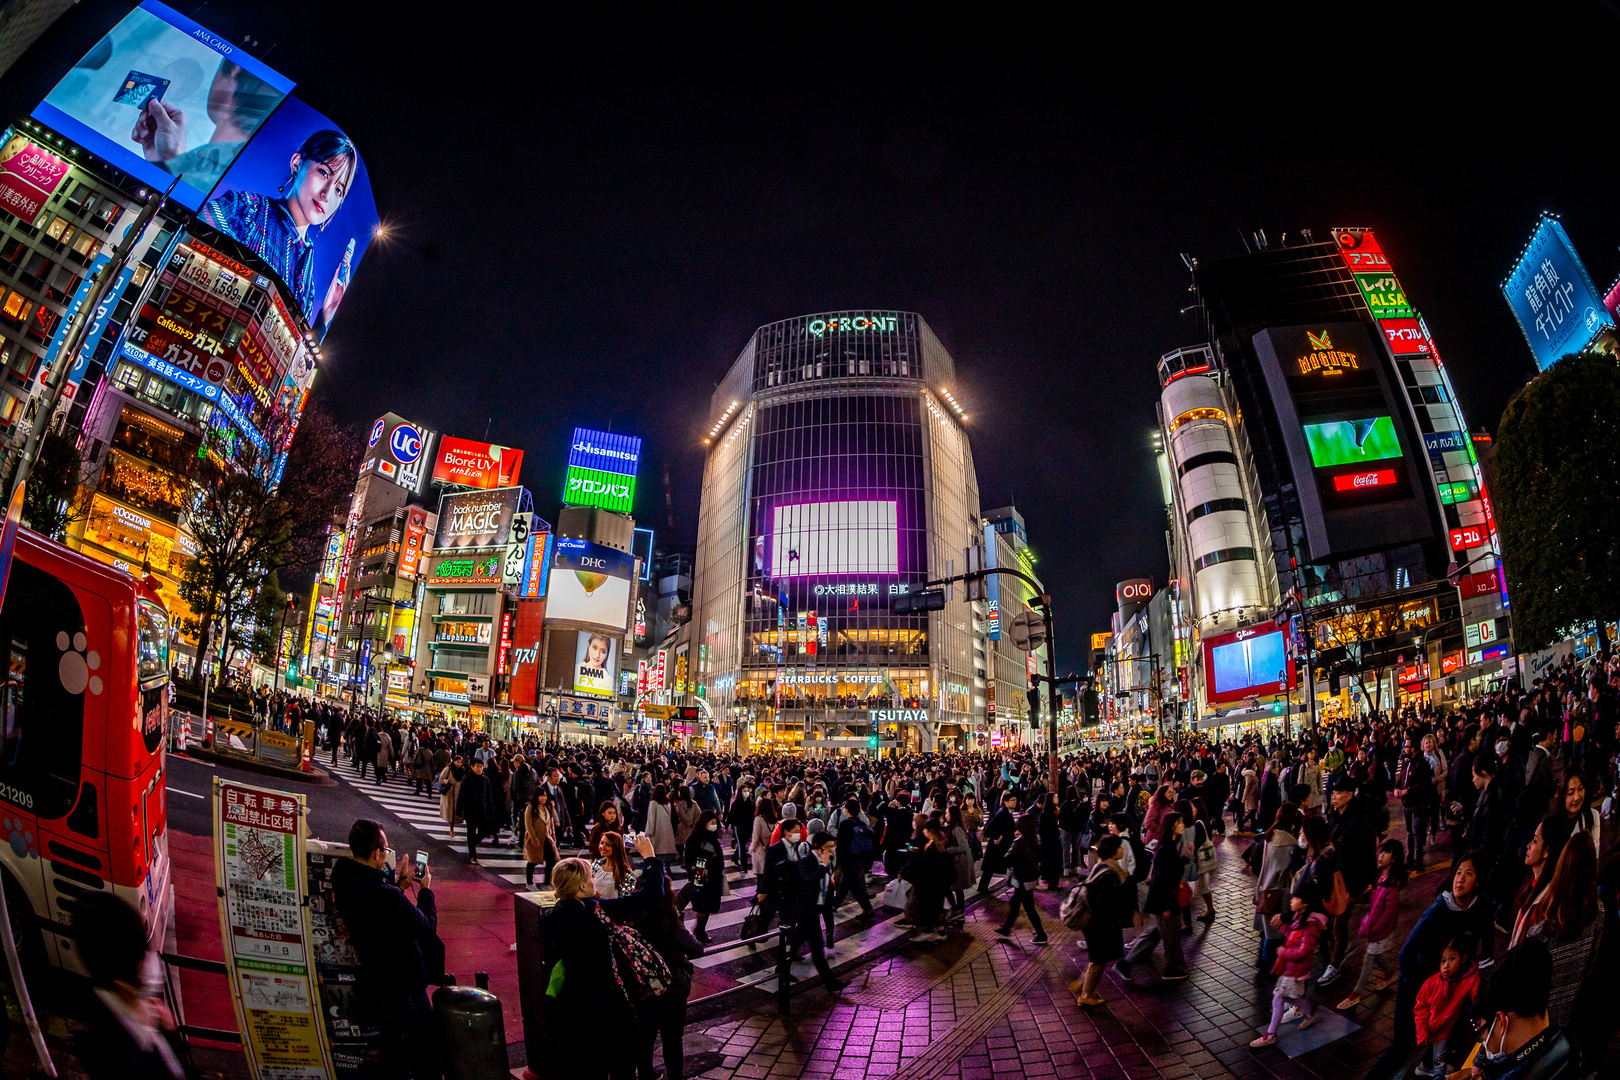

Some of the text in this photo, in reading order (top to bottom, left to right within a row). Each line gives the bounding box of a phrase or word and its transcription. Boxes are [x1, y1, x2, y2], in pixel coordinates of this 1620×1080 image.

[193, 29, 233, 56] ANA CARD
[22, 164, 53, 185] クリニック
[30, 154, 62, 176] 品川スキン
[172, 254, 186, 266] 9F
[190, 238, 253, 277] しゃぶしゃぶバイキング
[1349, 253, 1387, 265] アコム
[1508, 226, 1551, 297] のど、直接、うるおう
[183, 263, 212, 286] 1,199円
[1360, 278, 1397, 292] レイク
[212, 278, 242, 303] 1,599円
[1525, 257, 1560, 314] 龍角散
[1371, 293, 1408, 306] ALSA
[1535, 281, 1574, 341] ダイレクト
[149, 334, 167, 348] Café
[156, 315, 225, 356] Caféレストラン ガスト
[1385, 328, 1422, 341] アイフル
[162, 342, 203, 372] ガスト
[241, 331, 273, 379] コンタクト
[1298, 350, 1359, 374] MAGNET
[147, 356, 204, 390] 英会話イーオン
[208, 368, 223, 378] ガスト
[254, 384, 272, 408] ガスト
[394, 430, 421, 457] UC
[573, 441, 638, 462] Hisamitsu
[444, 452, 495, 471] Bioré UV
[449, 466, 483, 478] Athlizm
[402, 472, 417, 485] VISA
[570, 477, 630, 499] サロンパス
[1440, 486, 1466, 496] レイク ALSA
[113, 506, 151, 529] L'OCCITANE
[453, 502, 502, 515] back number
[449, 511, 501, 532] MAGIC
[503, 515, 529, 582] もんじゃ
[1453, 531, 1480, 546] アコム
[113, 559, 129, 572] Café
[528, 536, 543, 593] 三千里薬品
[581, 556, 607, 569] DHC
[825, 583, 879, 595] 大相撲結果
[1477, 583, 1487, 592] 入口
[989, 600, 1000, 634] SEIBU
[441, 632, 476, 643] Euphoria
[1237, 630, 1256, 641] Glico
[578, 676, 595, 687] FX
[580, 666, 604, 680] DMM
[778, 675, 883, 684] STARBUCKS COFFEE
[869, 710, 929, 722] TSUTAYA
[226, 788, 296, 815] 自転車等
[1516, 1035, 1546, 1062] SONY
